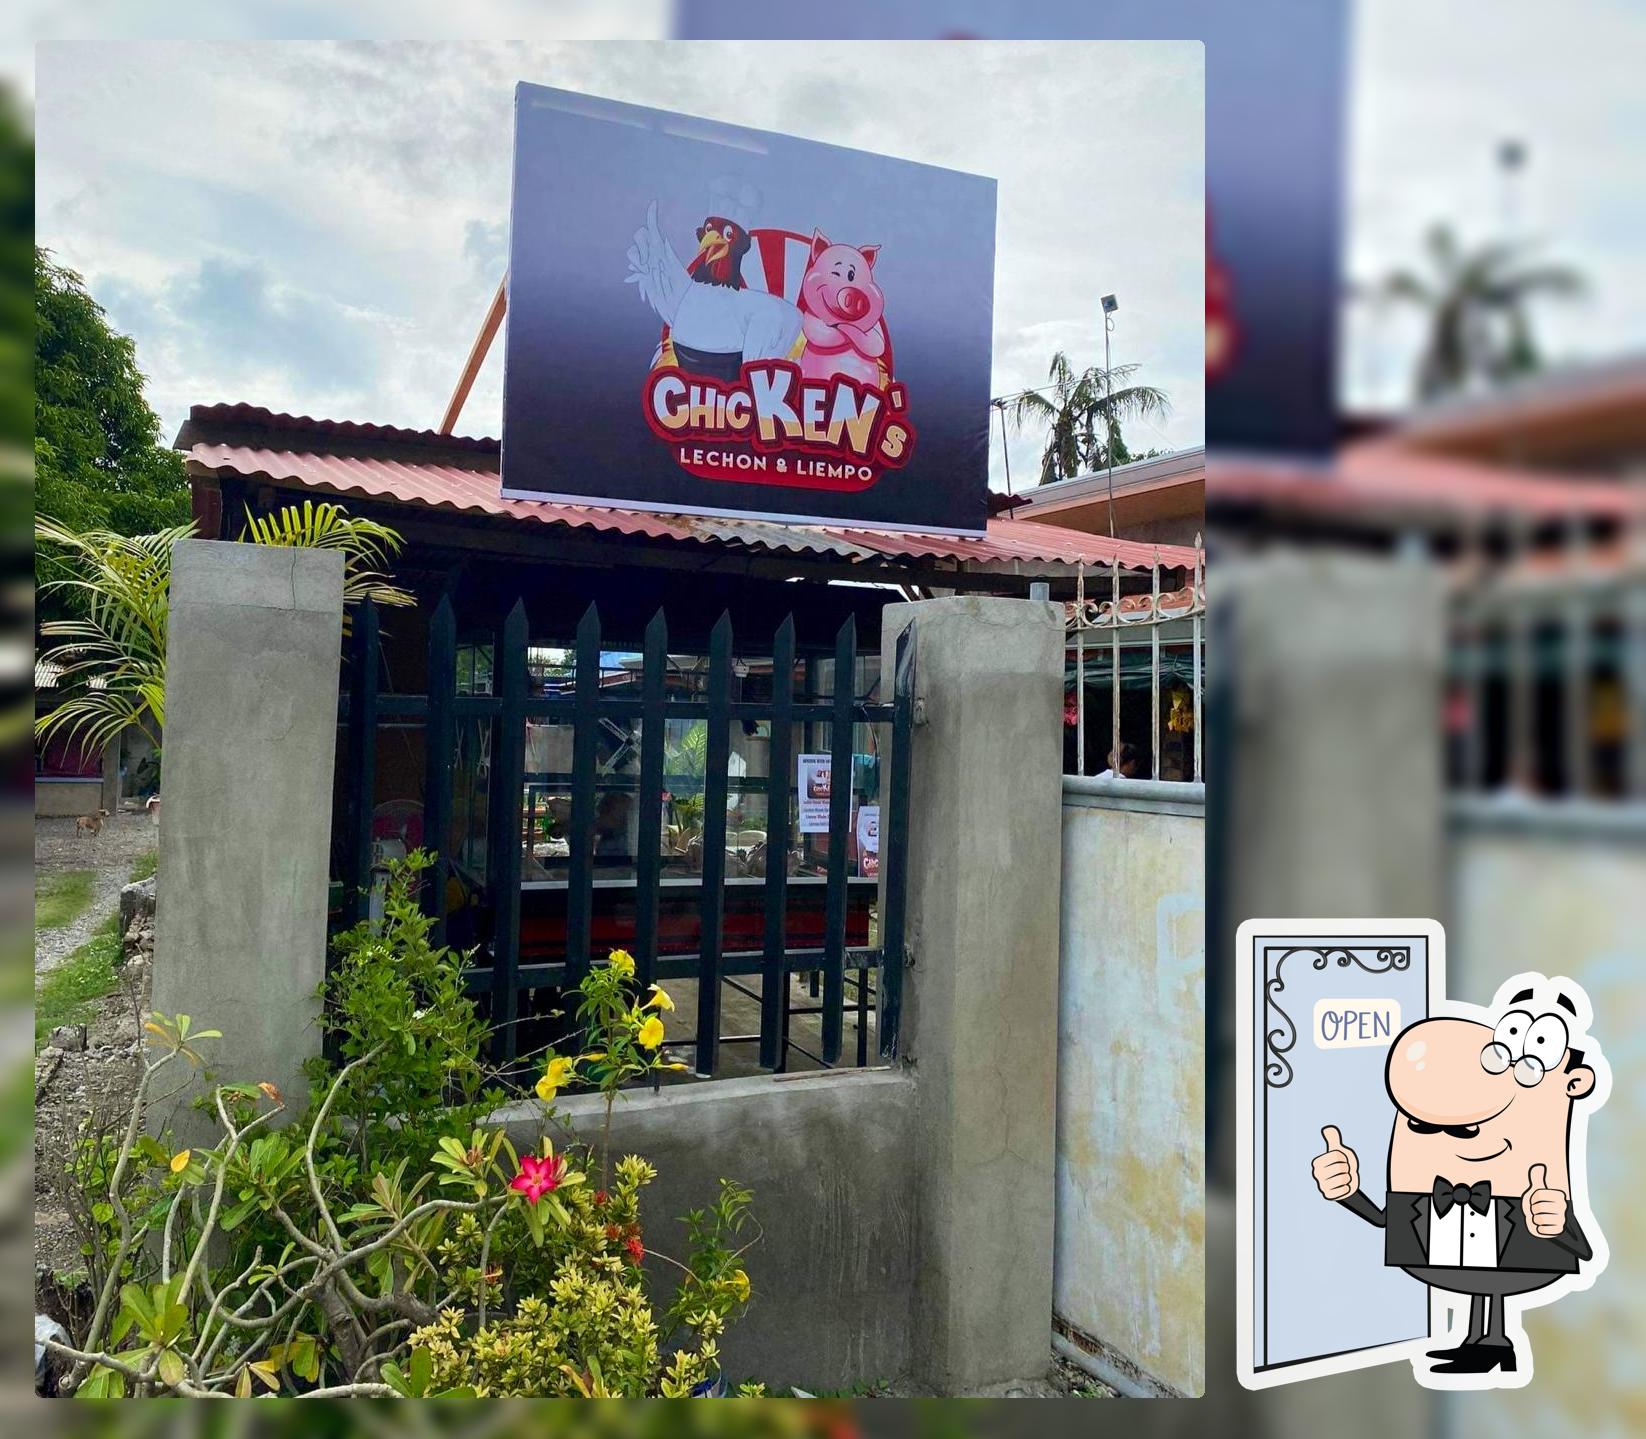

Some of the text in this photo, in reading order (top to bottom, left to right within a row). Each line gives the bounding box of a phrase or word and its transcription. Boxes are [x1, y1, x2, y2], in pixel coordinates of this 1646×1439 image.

[680, 448, 873, 481] LECHON & LIEMPO
